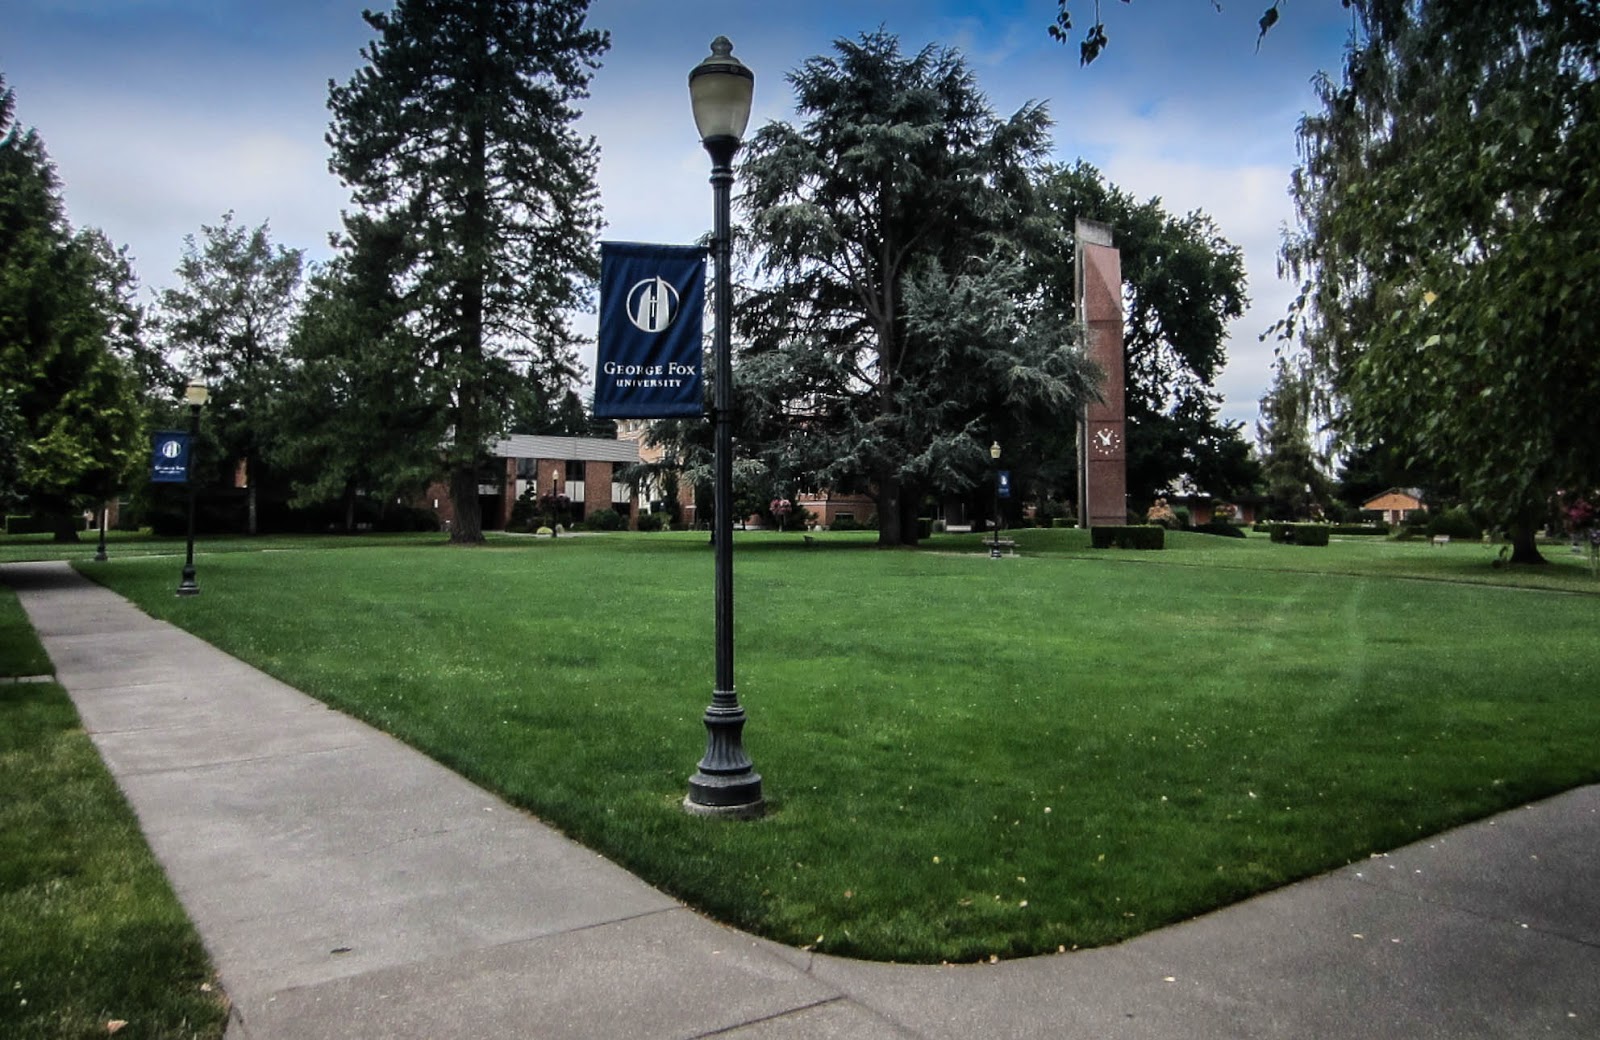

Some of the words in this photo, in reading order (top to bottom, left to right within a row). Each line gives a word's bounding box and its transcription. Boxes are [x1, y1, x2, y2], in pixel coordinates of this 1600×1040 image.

[604, 362, 663, 375] GEORGE
[668, 362, 696, 375] FOX
[616, 379, 682, 387] UNIVERSITY
